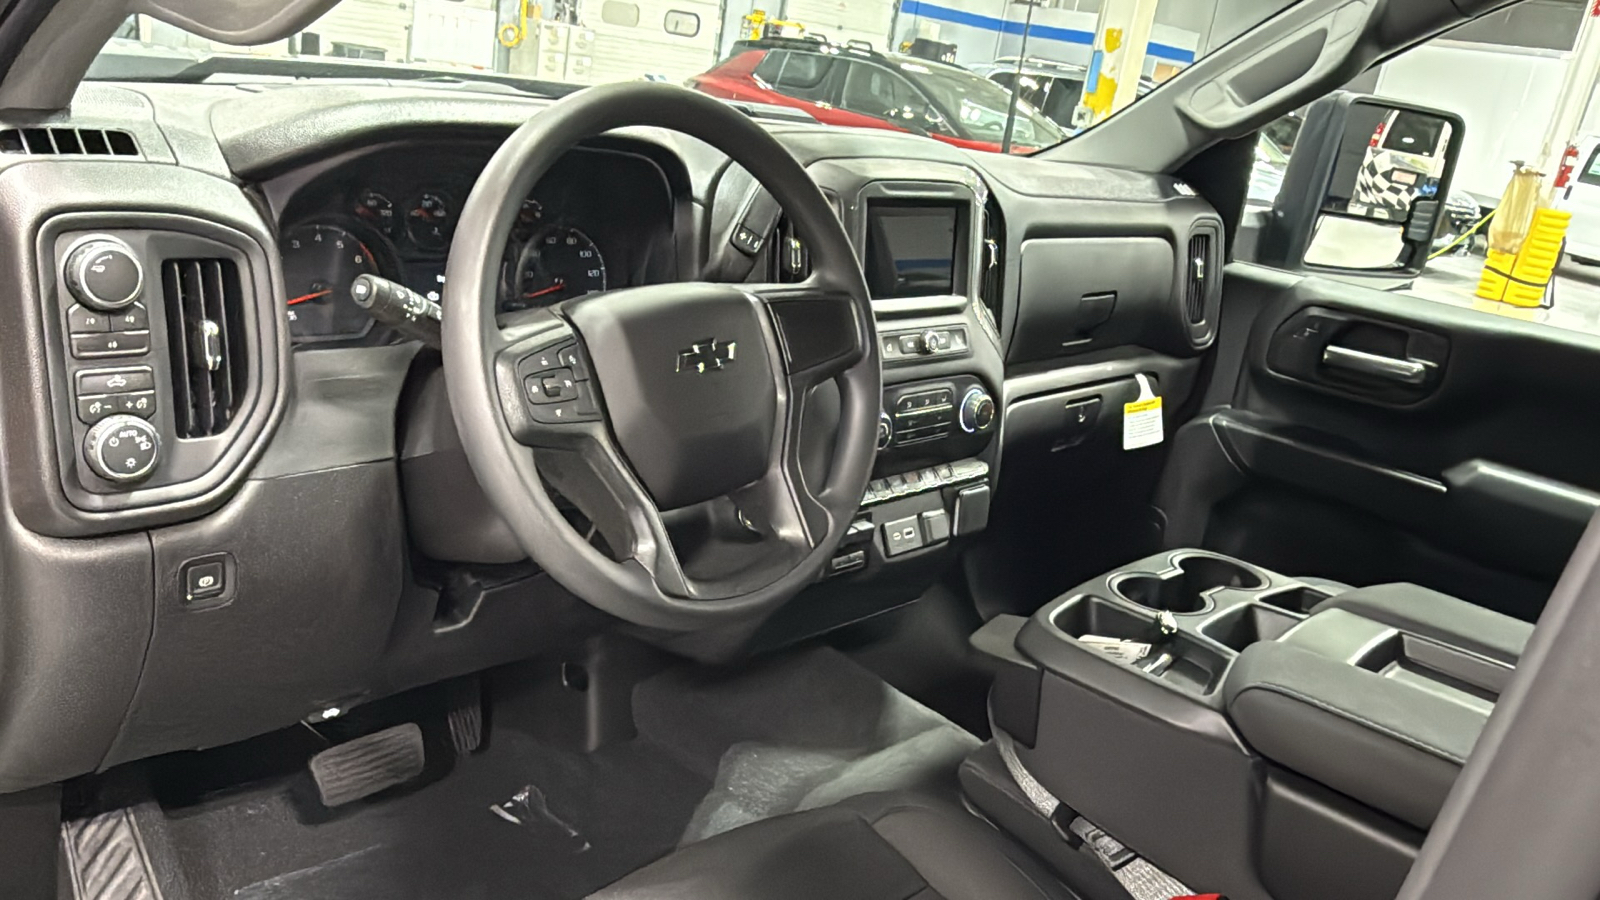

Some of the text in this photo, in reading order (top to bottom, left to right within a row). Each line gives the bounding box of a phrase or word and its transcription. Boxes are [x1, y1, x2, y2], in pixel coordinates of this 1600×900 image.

[314, 233, 322, 242] 4
[336, 240, 344, 249] 5
[579, 250, 592, 258] 100
[354, 255, 363, 264] 6
[588, 269, 599, 277] 120
[119, 429, 138, 438] AUTO
